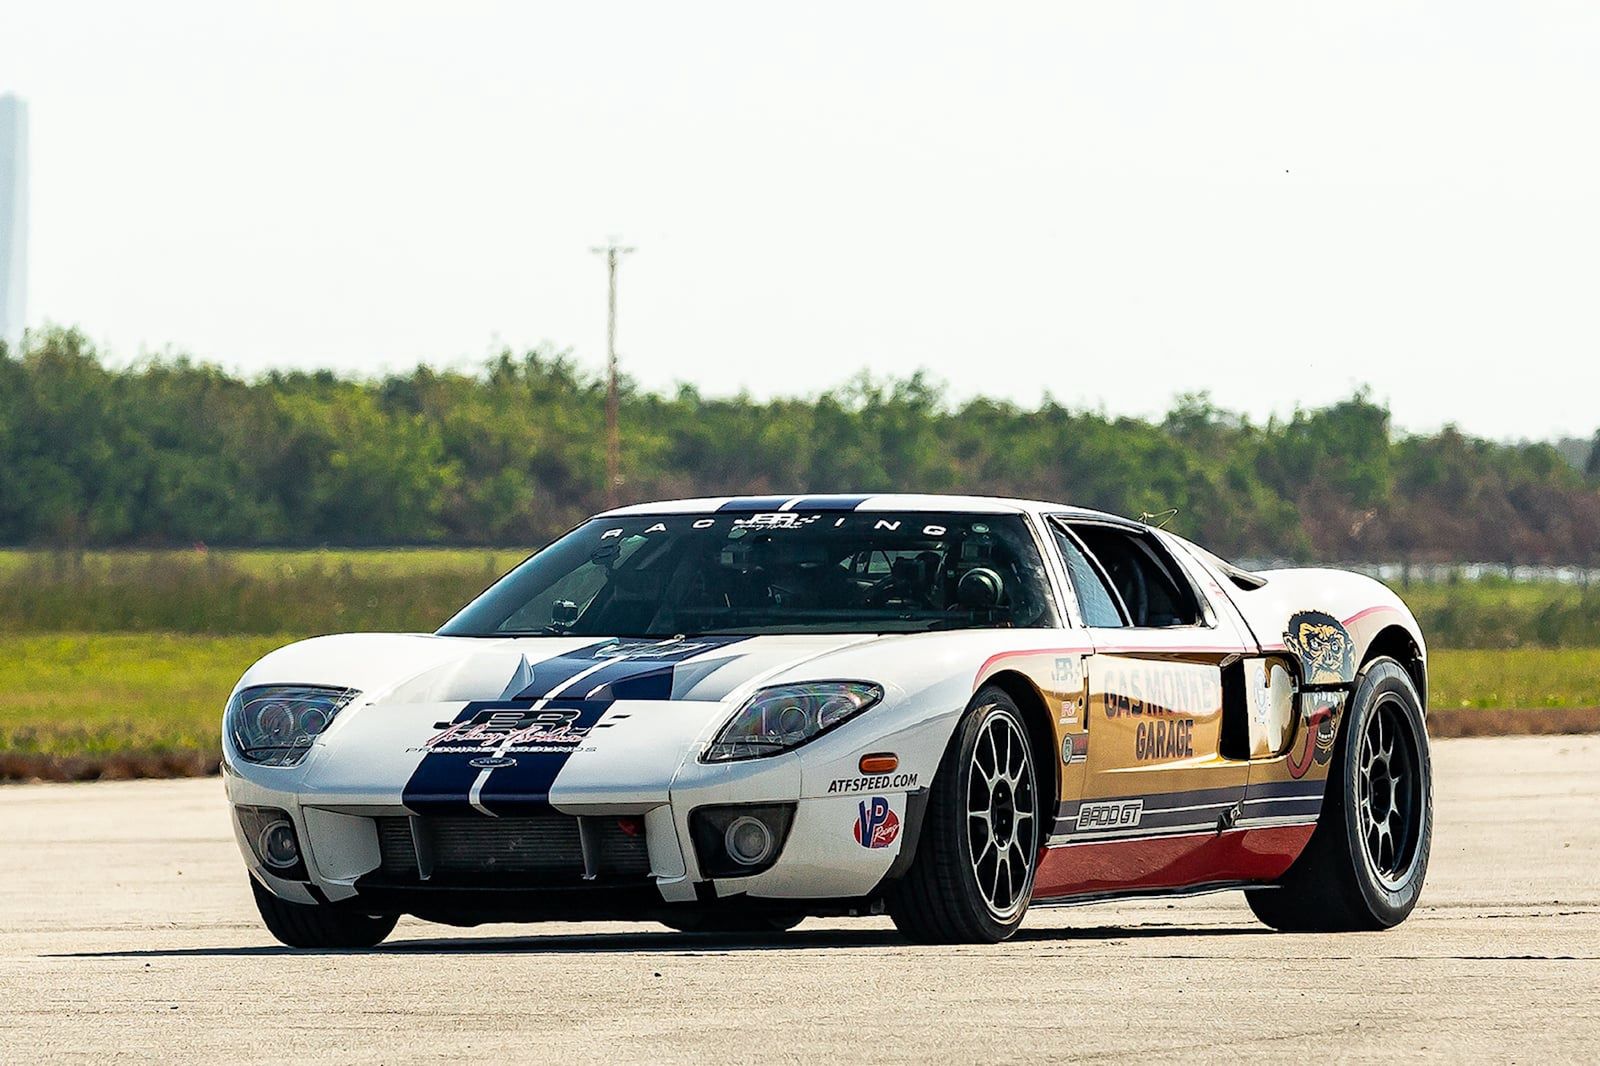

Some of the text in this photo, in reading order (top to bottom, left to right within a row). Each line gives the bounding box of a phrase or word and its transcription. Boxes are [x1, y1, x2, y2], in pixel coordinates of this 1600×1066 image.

[1104, 670, 1143, 719] GAS
[1136, 718, 1194, 761] GARAGE
[828, 773, 918, 793] ATFSPEED.COM
[858, 797, 889, 848] VP
[1120, 803, 1142, 824] GT
